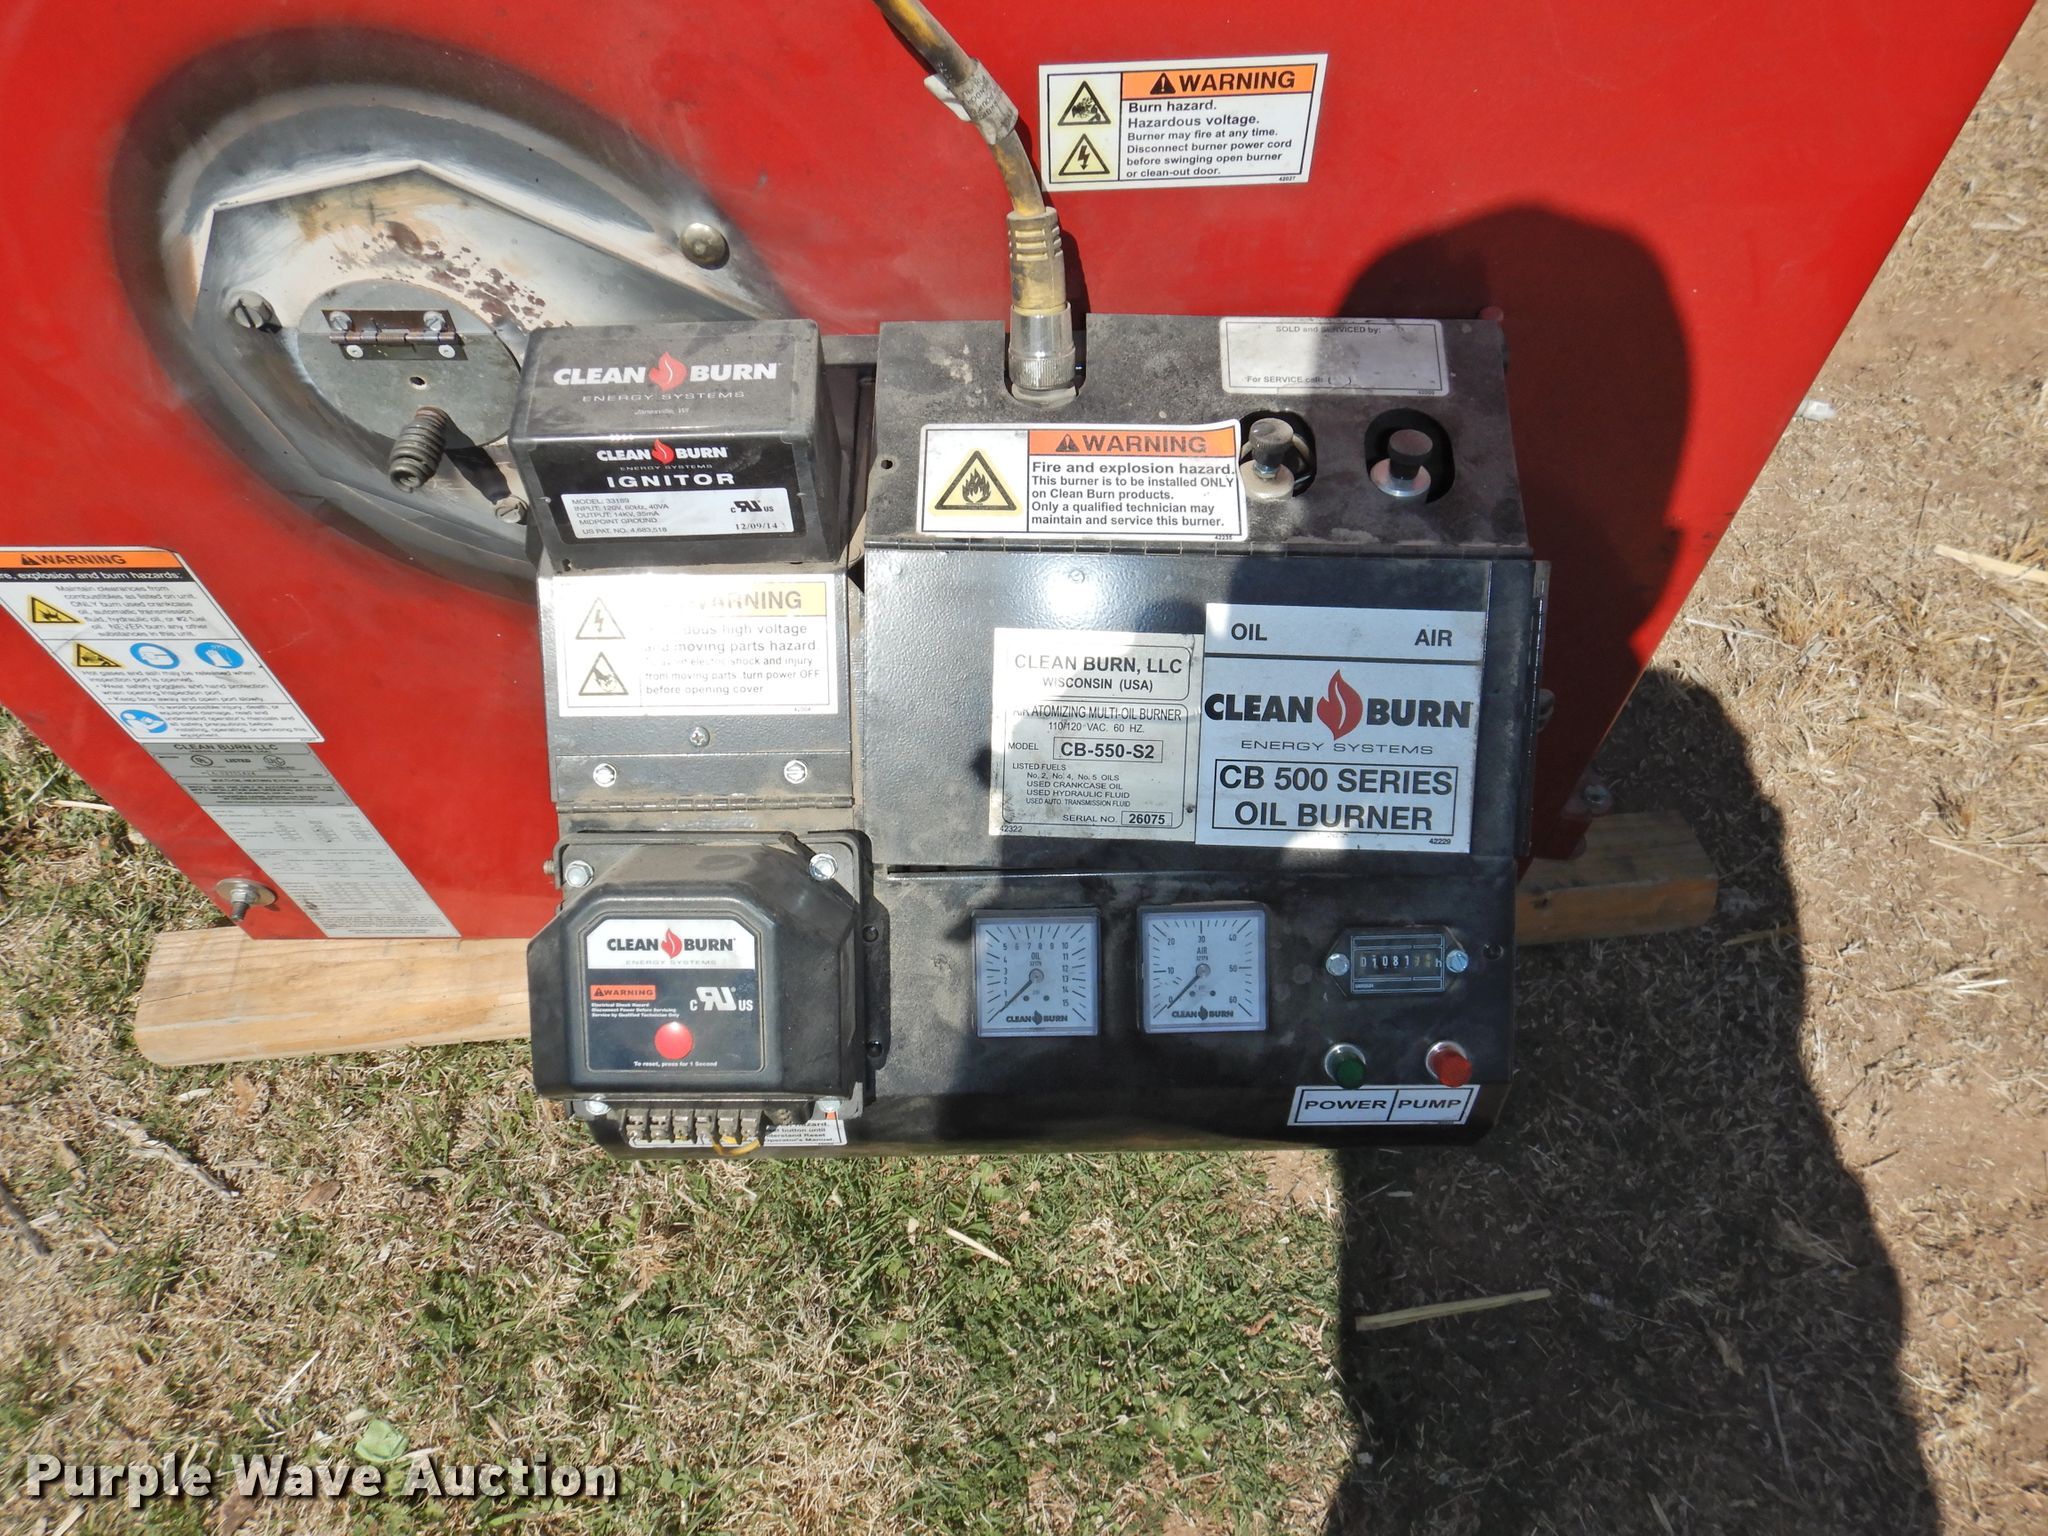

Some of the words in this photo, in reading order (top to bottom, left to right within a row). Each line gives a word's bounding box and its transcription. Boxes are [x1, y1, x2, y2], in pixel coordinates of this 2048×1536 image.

[1179, 70, 1295, 92] WARNING
[1129, 102, 1161, 113] Burn
[1167, 100, 1216, 111] hazard.
[1128, 116, 1201, 128] Hazardous
[1206, 115, 1259, 127] voltage.
[1128, 131, 1164, 141] Burner
[1168, 132, 1190, 141] may
[1194, 130, 1211, 138] fire
[1215, 130, 1226, 138] at
[1229, 130, 1248, 139] any
[1251, 128, 1278, 136] time.
[1127, 143, 1187, 154] Disconnect
[1192, 142, 1227, 151] burner
[1231, 140, 1264, 150] power
[1268, 139, 1292, 148] cord
[1127, 156, 1161, 166] before
[1164, 155, 1212, 165] swinging
[1216, 154, 1243, 164] open
[1246, 152, 1282, 161] burner
[1126, 169, 1137, 177] or
[1140, 168, 1190, 177] clean-out
[1194, 167, 1220, 175] door.
[554, 367, 646, 386] CLEAN
[690, 363, 778, 382] BURN
[582, 394, 651, 402] ENERGY
[1083, 435, 1206, 453] WARNING
[597, 449, 651, 462] CLEAN
[676, 447, 728, 459] BURN
[1032, 462, 1061, 473] Fire
[1066, 463, 1095, 473] and
[1100, 463, 1174, 475] explosion
[1179, 463, 1234, 475] hazard.
[606, 473, 735, 488] IGNITOR
[1032, 476, 1057, 486] This
[1061, 476, 1099, 486] burner
[1102, 477, 1111, 486] is
[1115, 478, 1127, 487] to
[1130, 477, 1144, 487] be
[1148, 477, 1197, 487] installed
[1200, 478, 1233, 487] ONLY
[1032, 490, 1046, 499] on
[1050, 489, 1083, 499] Clean
[1087, 489, 1115, 499] Burn
[1119, 489, 1174, 501] products.
[1032, 502, 1058, 514] Only
[1062, 504, 1069, 512] a
[1073, 502, 1123, 515] qualified
[1126, 503, 1187, 513] technician
[1190, 505, 1214, 515] may
[735, 522, 778, 530] 12/09/14
[1032, 515, 1082, 525] maintain
[1086, 516, 1107, 525] and
[1111, 516, 1153, 526] service
[1157, 516, 1174, 526] this
[1178, 516, 1224, 526] burner.
[37, 555, 127, 564] WARNING
[18, 573, 74, 581] explosion
[757, 624, 807, 636] voltage
[1231, 623, 1267, 641] OIL
[1415, 629, 1452, 646] AIR
[731, 641, 764, 653] parts
[770, 640, 816, 651] hazard
[764, 657, 781, 665] and
[1015, 655, 1076, 670] CLEAN
[1084, 656, 1140, 674] BURN,
[1147, 659, 1182, 673] LLC
[743, 671, 762, 679] turn
[766, 671, 796, 680] power
[1043, 677, 1112, 689] WISCONSIN
[1120, 679, 1153, 692] (USA)
[1032, 705, 1086, 718] ATOMIZING
[1089, 707, 1137, 720] MULTI-OIL
[1140, 708, 1181, 721] BURNER
[1204, 694, 1314, 723] CLEAN
[1366, 698, 1471, 728] BURN
[1049, 722, 1081, 731] 110/120
[1087, 723, 1108, 732] VAC.
[1114, 724, 1124, 732] 60
[1130, 724, 1144, 733] HZ.
[1008, 742, 1039, 750] MODEL
[1060, 742, 1154, 759] CB-550-S2
[1241, 740, 1324, 751] ENERGY
[1333, 743, 1433, 754] SYSTEMS
[1220, 765, 1265, 789] CB
[1274, 768, 1328, 791] 500
[1337, 768, 1452, 795] SERIES
[1053, 790, 1103, 798] HYDRAULIC
[1129, 814, 1165, 824] 26075
[1235, 801, 1287, 826] OIL
[1298, 803, 1433, 830] BURNER
[607, 938, 658, 951] CLEAN
[684, 939, 733, 951] BURN
[739, 1000, 753, 1011] US
[1305, 1100, 1387, 1110] POWER
[1398, 1100, 1461, 1109] PUMP
